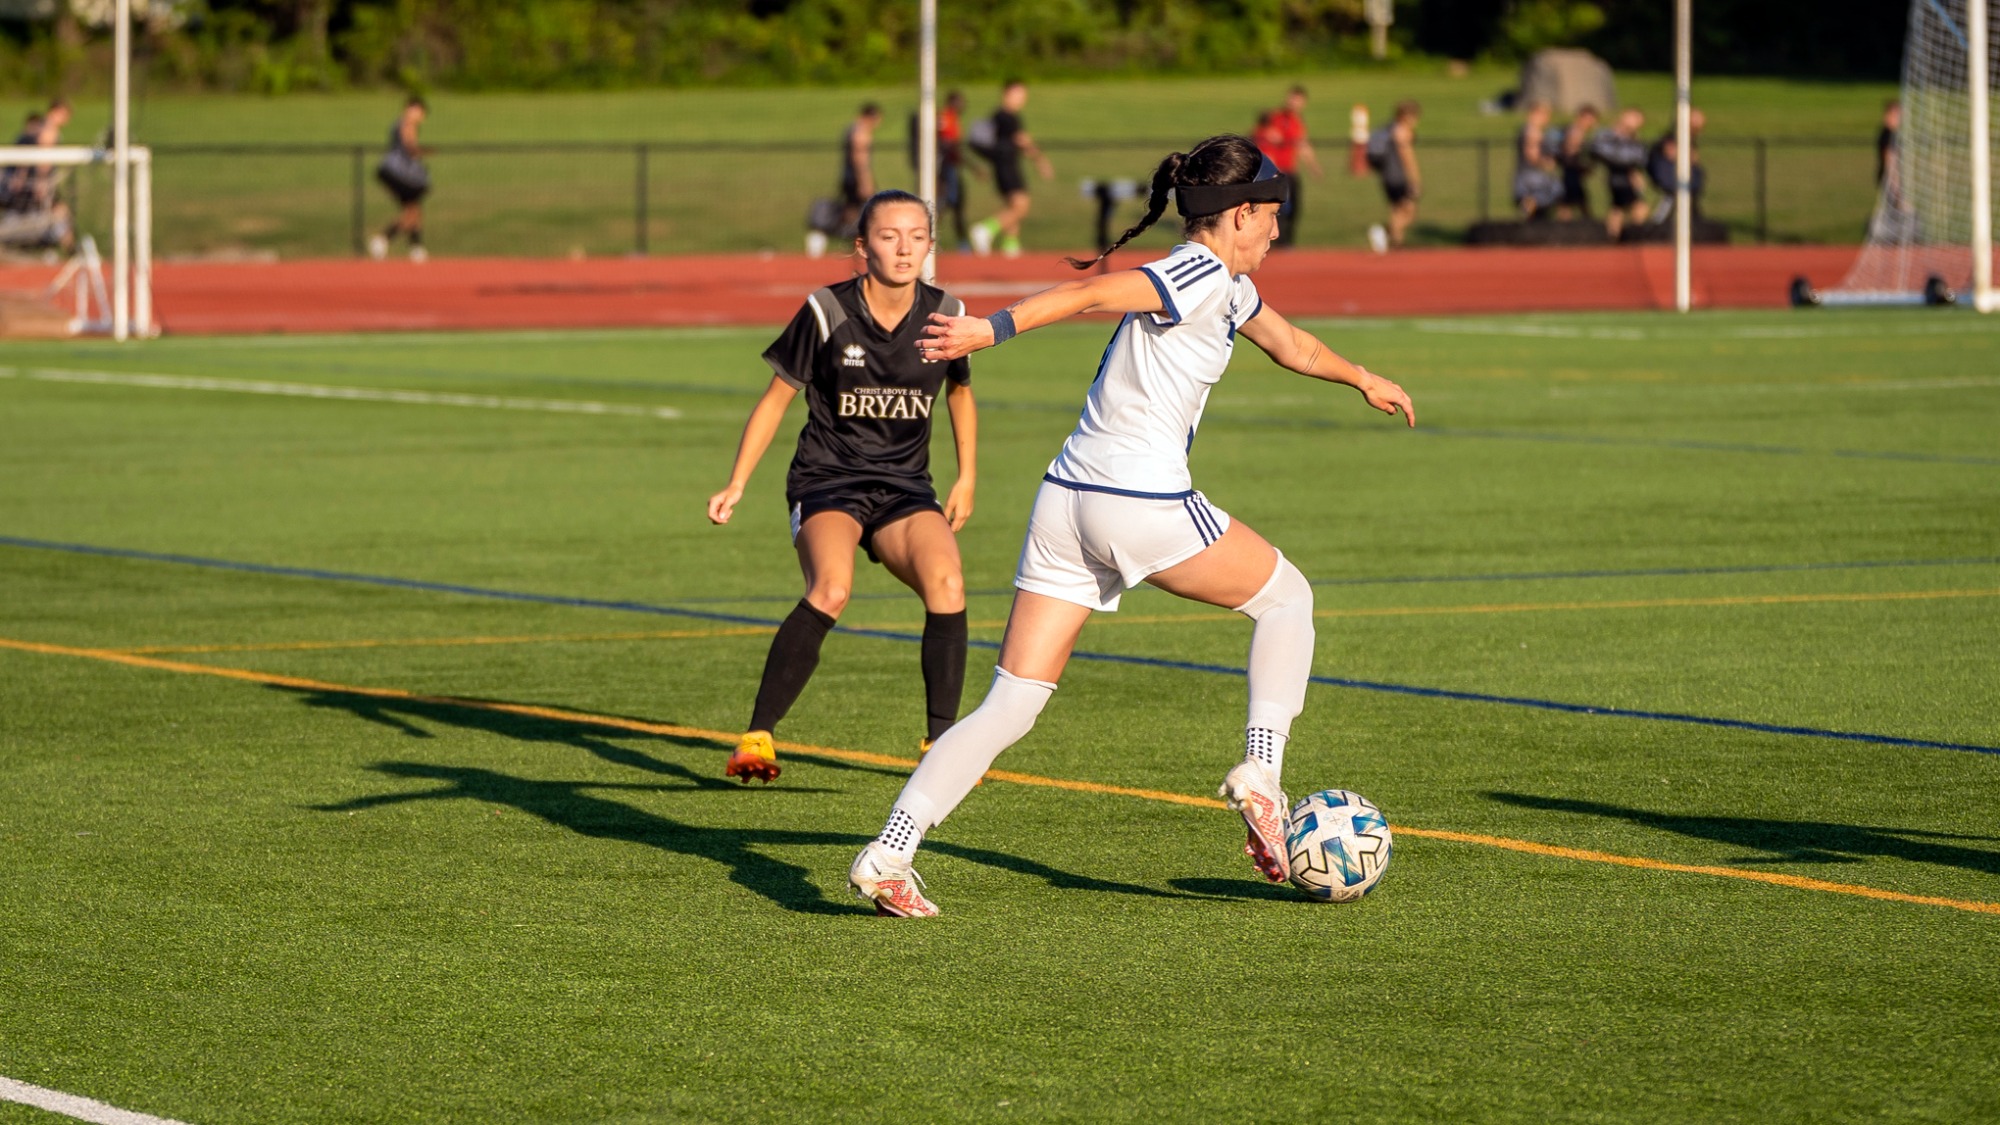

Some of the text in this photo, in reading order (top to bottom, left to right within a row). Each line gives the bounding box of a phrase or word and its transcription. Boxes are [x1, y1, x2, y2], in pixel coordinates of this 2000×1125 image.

[854, 387, 881, 395] CHRIST
[882, 388, 907, 396] ABOVE
[839, 393, 933, 419] BRYAN
